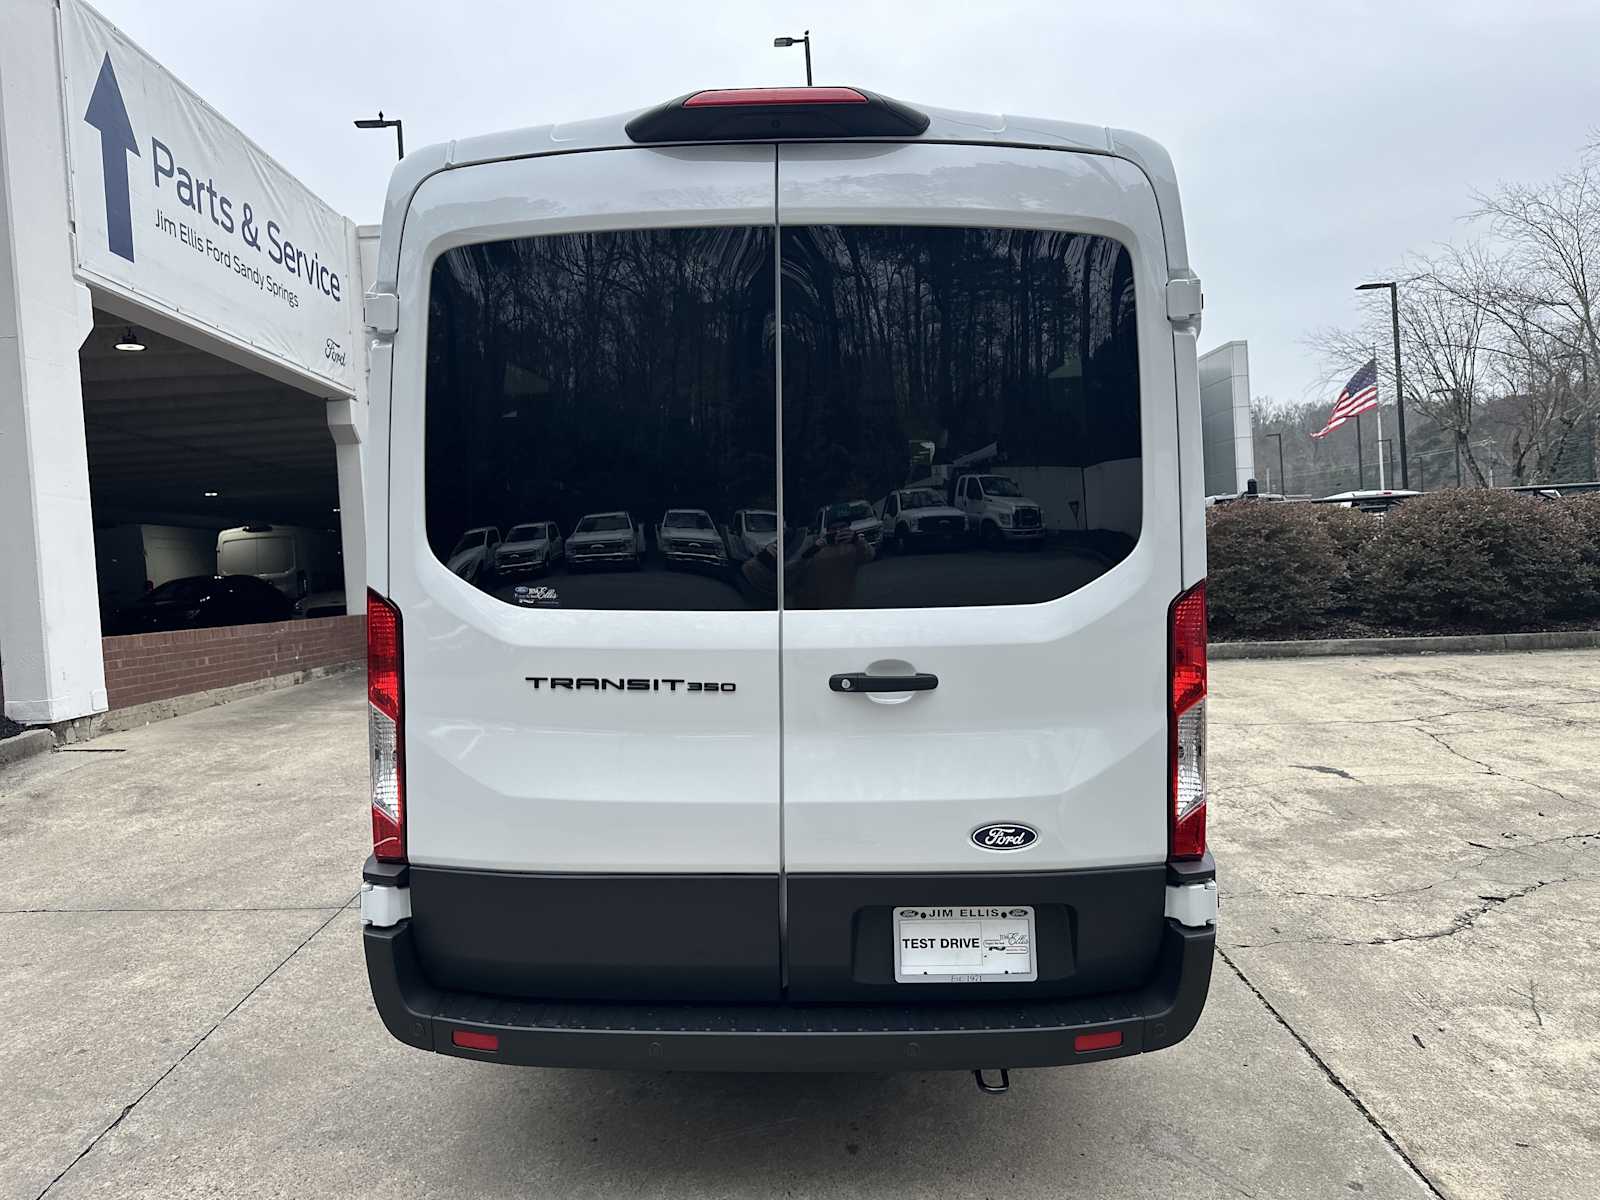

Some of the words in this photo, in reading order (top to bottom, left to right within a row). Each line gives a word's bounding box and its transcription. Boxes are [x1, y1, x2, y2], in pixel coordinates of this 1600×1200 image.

[151, 136, 235, 234] Parts
[240, 202, 261, 252] &
[267, 220, 341, 302] Service
[155, 209, 178, 239] Jim
[180, 224, 204, 253] Ellis
[206, 239, 232, 269] Ford
[233, 256, 265, 293] Sandy
[266, 275, 300, 309] Springs
[324, 337, 346, 367] Ford
[928, 908, 954, 918] JIM
[959, 908, 1000, 917] ELLIS
[902, 938, 936, 949] TEST
[940, 938, 980, 949] DRIVE
